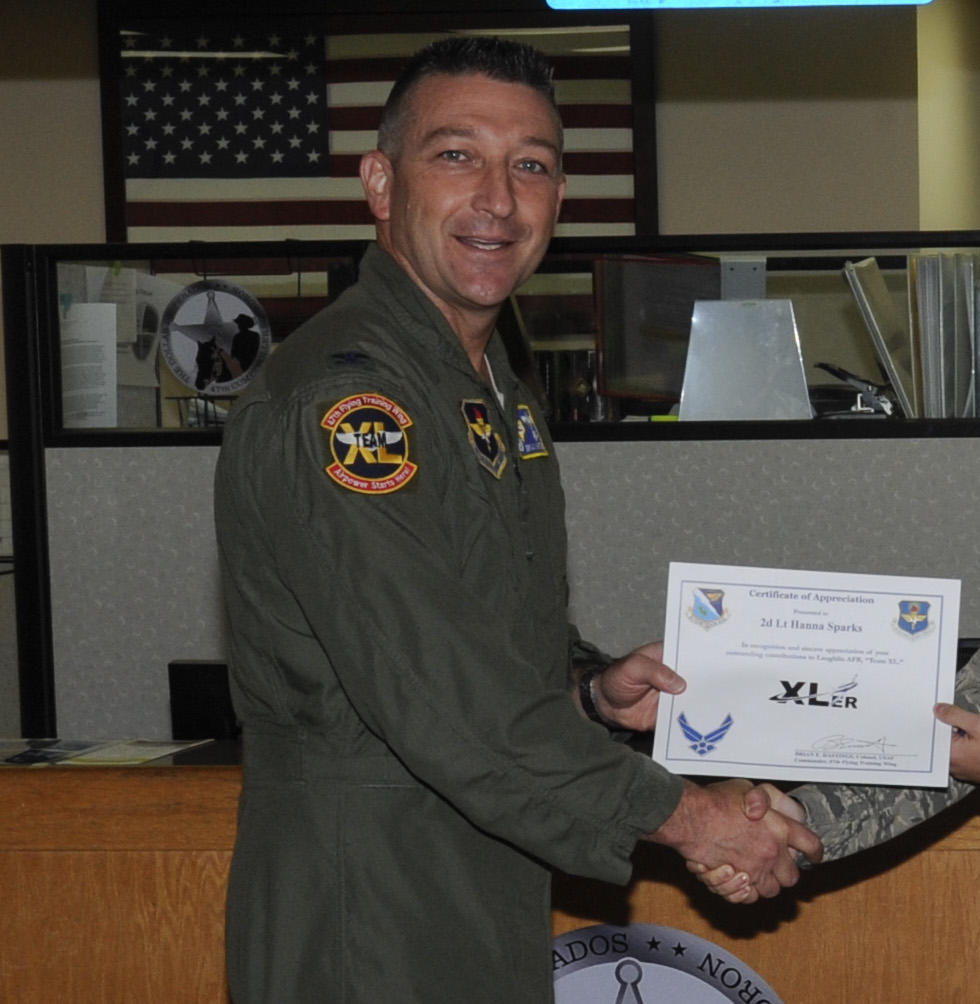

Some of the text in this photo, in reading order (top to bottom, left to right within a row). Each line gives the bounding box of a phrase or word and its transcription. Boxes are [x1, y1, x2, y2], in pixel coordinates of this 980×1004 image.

[353, 431, 387, 448] TEAM
[749, 589, 875, 604] Certificate of Appreciation
[760, 617, 863, 634] 2d Lt Hanna Sparks
